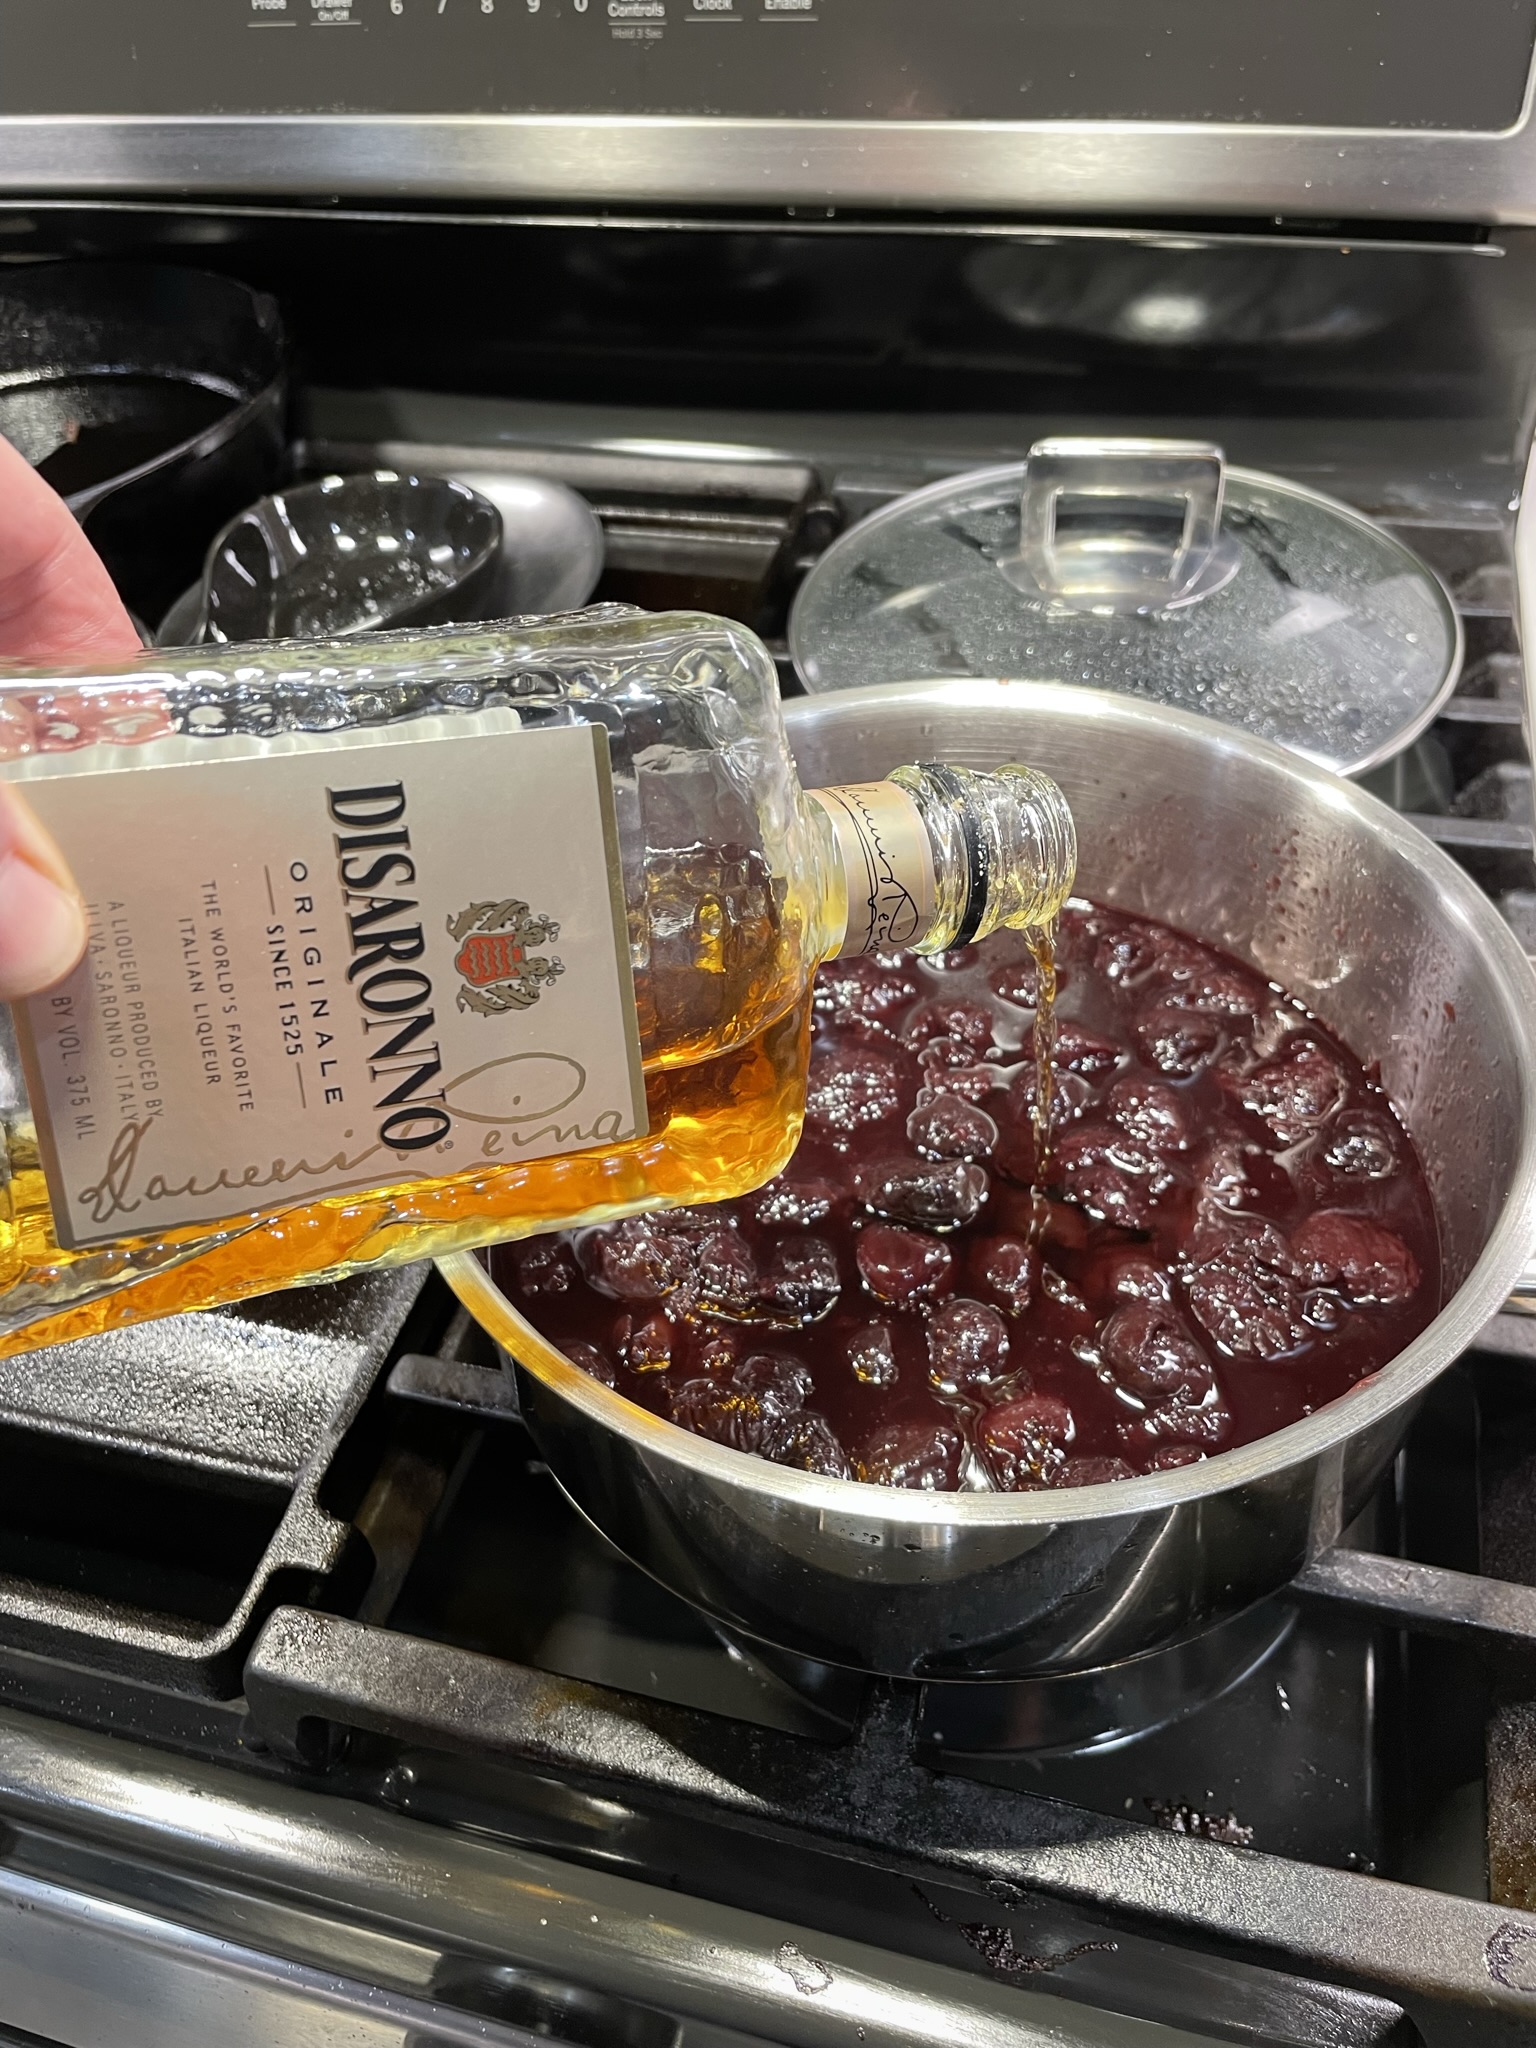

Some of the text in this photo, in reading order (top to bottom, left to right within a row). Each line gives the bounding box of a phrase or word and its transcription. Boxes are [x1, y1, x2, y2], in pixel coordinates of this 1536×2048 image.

[607, 2, 666, 17] Controls
[94, 971, 128, 1058] SARONNO
[114, 1075, 139, 1122] ITALY
[107, 901, 165, 1119] A LIQUEUR PRODUCED BY
[178, 918, 222, 1086] ITALIAN LIQUEUR
[201, 880, 255, 1112] THE WORLD'S FAVORITE
[266, 925, 304, 1056] SINCE 1525
[290, 861, 344, 1105] ORIGINALE
[325, 779, 451, 1152] DISARONNO
[51, 996, 97, 1141] BY VOL. 375 ML
